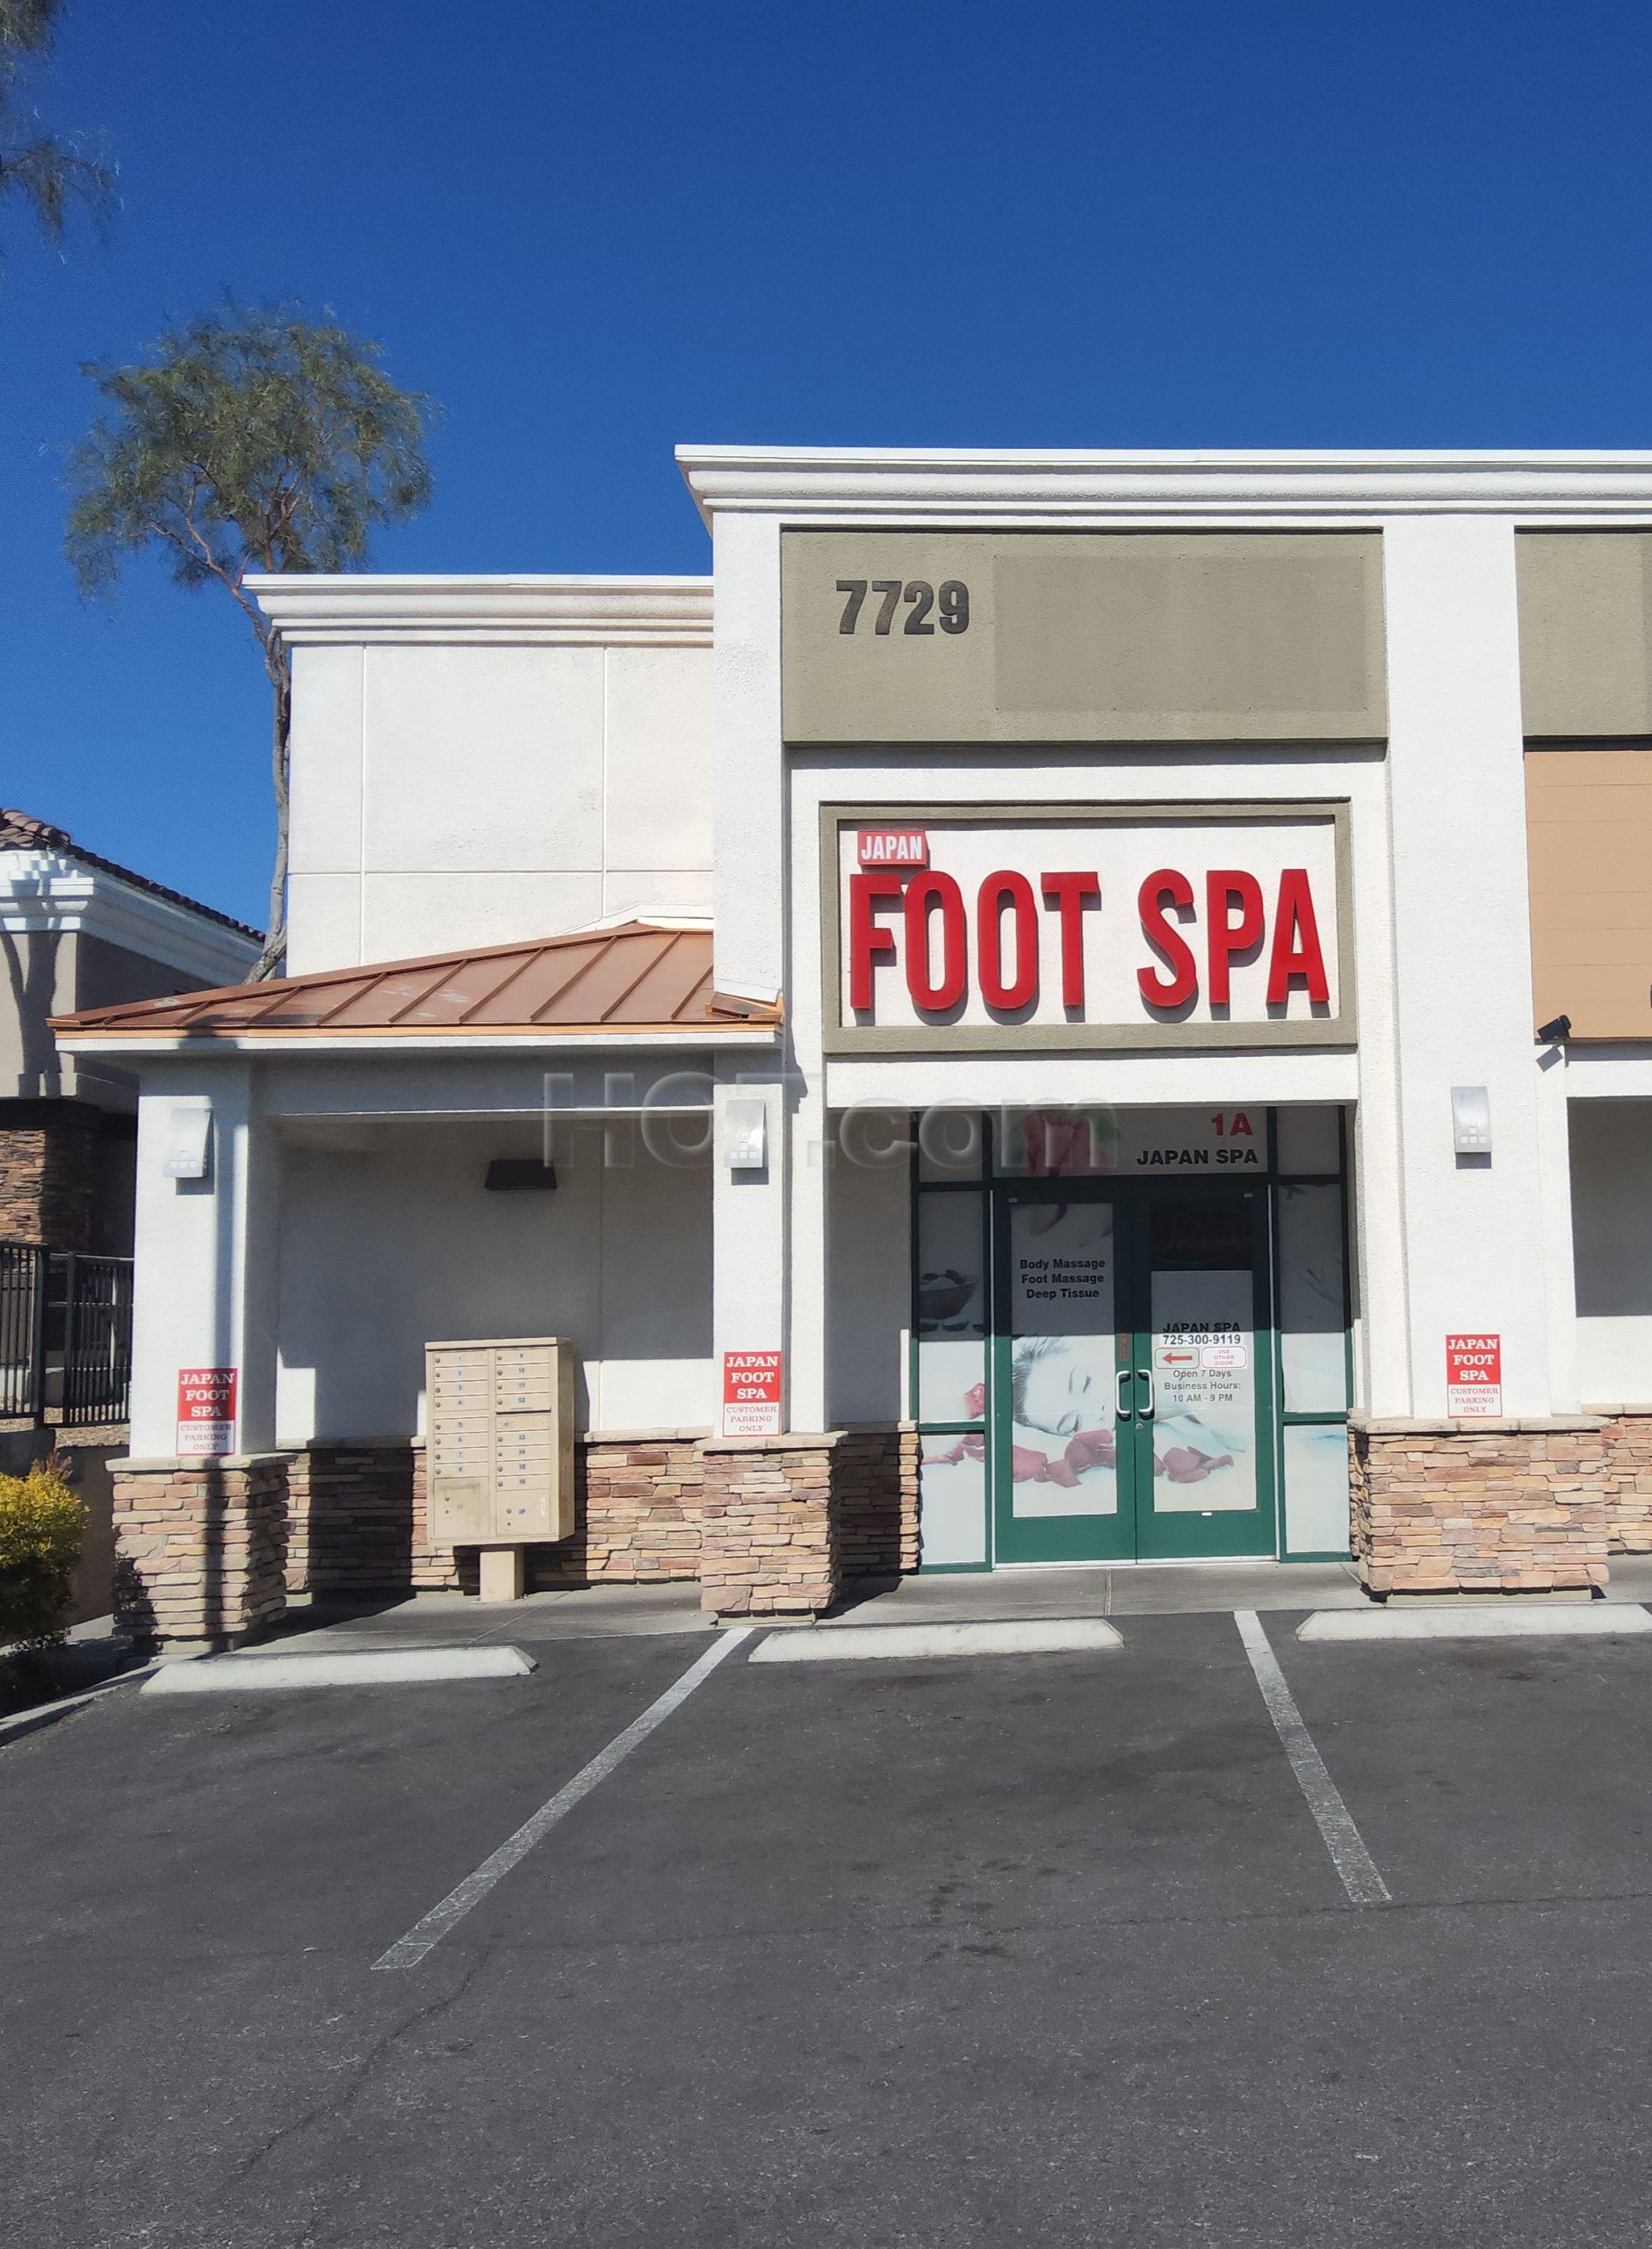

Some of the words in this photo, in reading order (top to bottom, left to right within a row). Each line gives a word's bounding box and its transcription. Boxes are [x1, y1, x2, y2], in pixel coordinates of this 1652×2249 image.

[835, 580, 970, 635] 7729
[861, 835, 922, 860] JAPAN
[849, 870, 1100, 1011] FOOT
[1136, 868, 1331, 1008] SPA
[1210, 1112, 1253, 1136] 1A
[1136, 1149, 1208, 1166] JAPAN
[1216, 1148, 1259, 1164] SPA
[1020, 1259, 1050, 1270] Body
[1053, 1258, 1106, 1269] Massage
[1021, 1274, 1048, 1284] Foot
[1051, 1273, 1104, 1284] Massage
[1026, 1289, 1057, 1299] Deep
[1060, 1288, 1100, 1298] Tissue
[1162, 1322, 1209, 1333] JAPAN
[1213, 1322, 1241, 1333] SPA
[1163, 1334, 1241, 1345] 725-300-9119
[1448, 1339, 1498, 1349] JAPAN
[726, 1356, 779, 1368] JAPAN
[1454, 1354, 1495, 1365] FOOT
[181, 1373, 234, 1385] JAPAN
[731, 1371, 775, 1384] FOOT
[1173, 1370, 1198, 1380] Open
[1208, 1370, 1232, 1379] Days
[1460, 1370, 1490, 1381] SPA
[1164, 1382, 1208, 1391] Business
[184, 1390, 230, 1401] FOOT
[737, 1387, 768, 1399] SPA
[1172, 1394, 1184, 1403] 10
[1186, 1394, 1201, 1403] AM
[1218, 1393, 1233, 1402] PM
[191, 1406, 222, 1417] SPA
